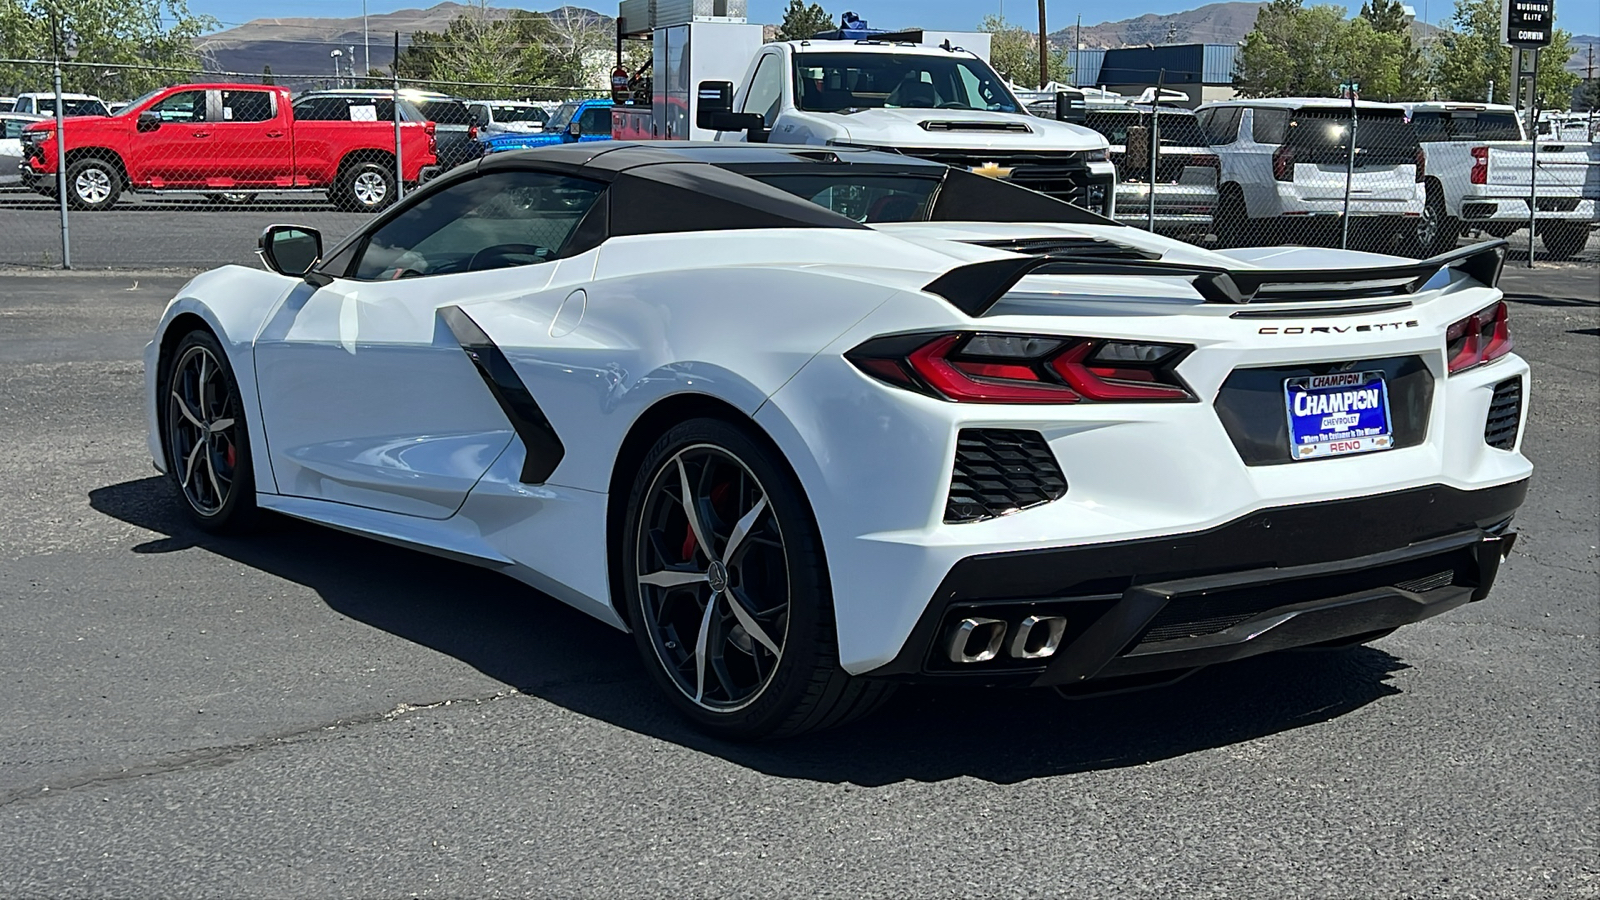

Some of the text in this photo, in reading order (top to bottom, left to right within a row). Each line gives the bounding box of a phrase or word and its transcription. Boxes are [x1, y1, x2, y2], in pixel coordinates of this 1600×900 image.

[1517, 3, 1548, 12] BUSINESS
[1523, 13, 1542, 21] ELITE
[1518, 31, 1544, 40] CORWIN
[1258, 320, 1419, 334] CORVETTE
[1313, 374, 1360, 387] CHAMPION
[1294, 389, 1379, 417] CHAMPION
[1323, 416, 1357, 427] CHEVROLET
[1330, 441, 1361, 453] RENO
